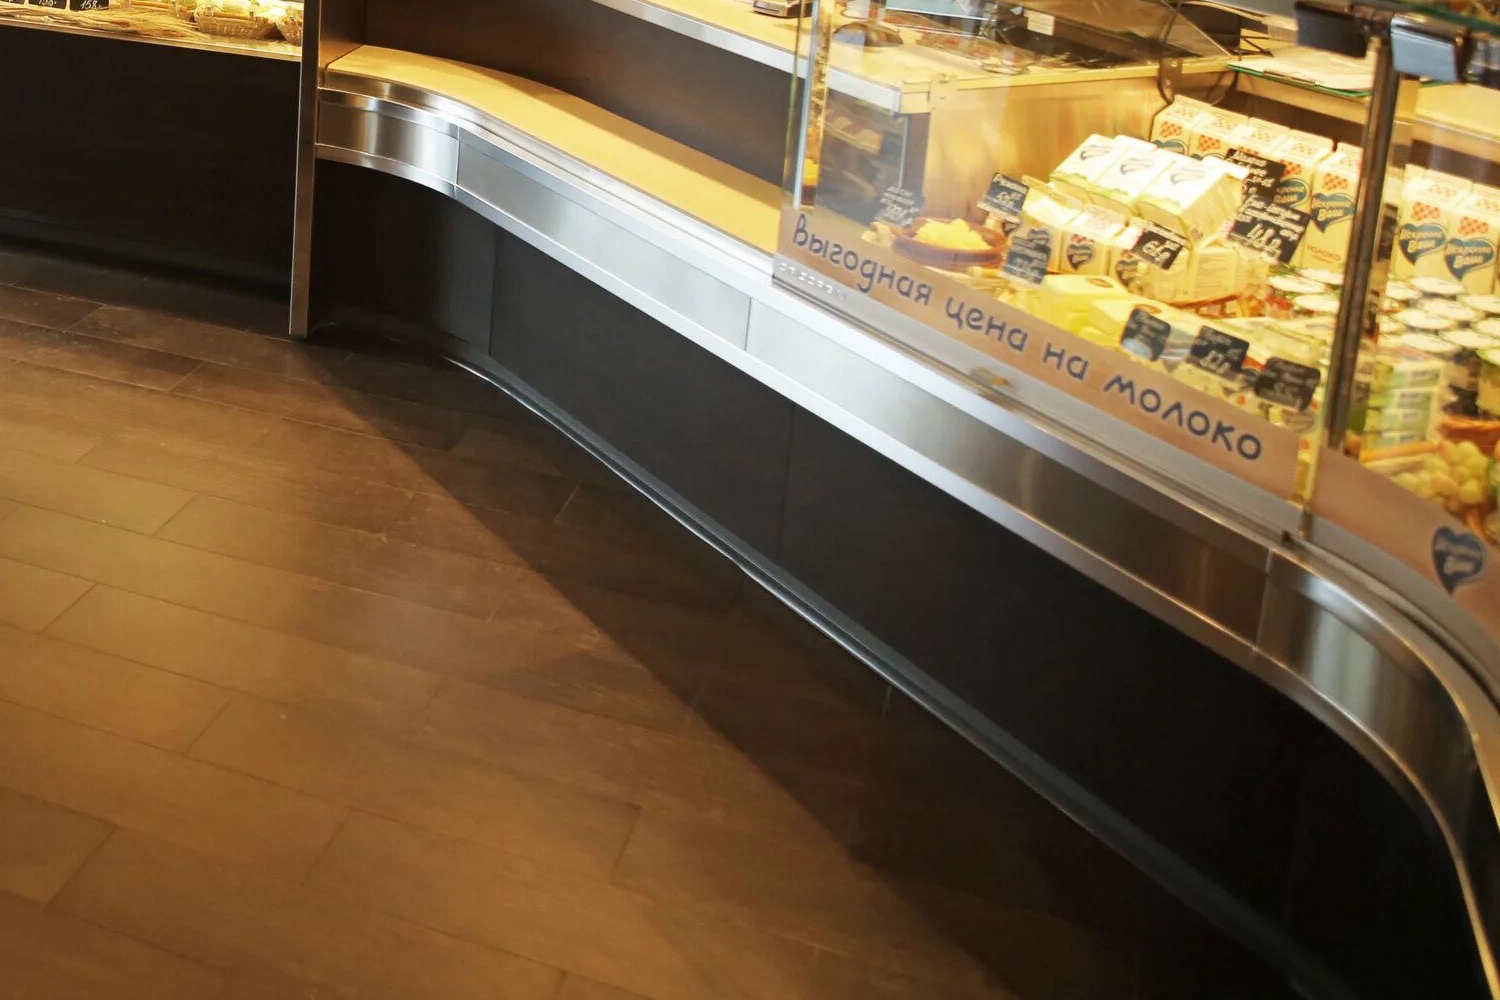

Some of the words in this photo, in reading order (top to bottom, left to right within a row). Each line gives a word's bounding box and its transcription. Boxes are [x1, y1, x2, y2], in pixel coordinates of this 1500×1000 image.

[944, 293, 1028, 353] цена
[1041, 341, 1091, 381] на
[1104, 373, 1264, 462] молоко
